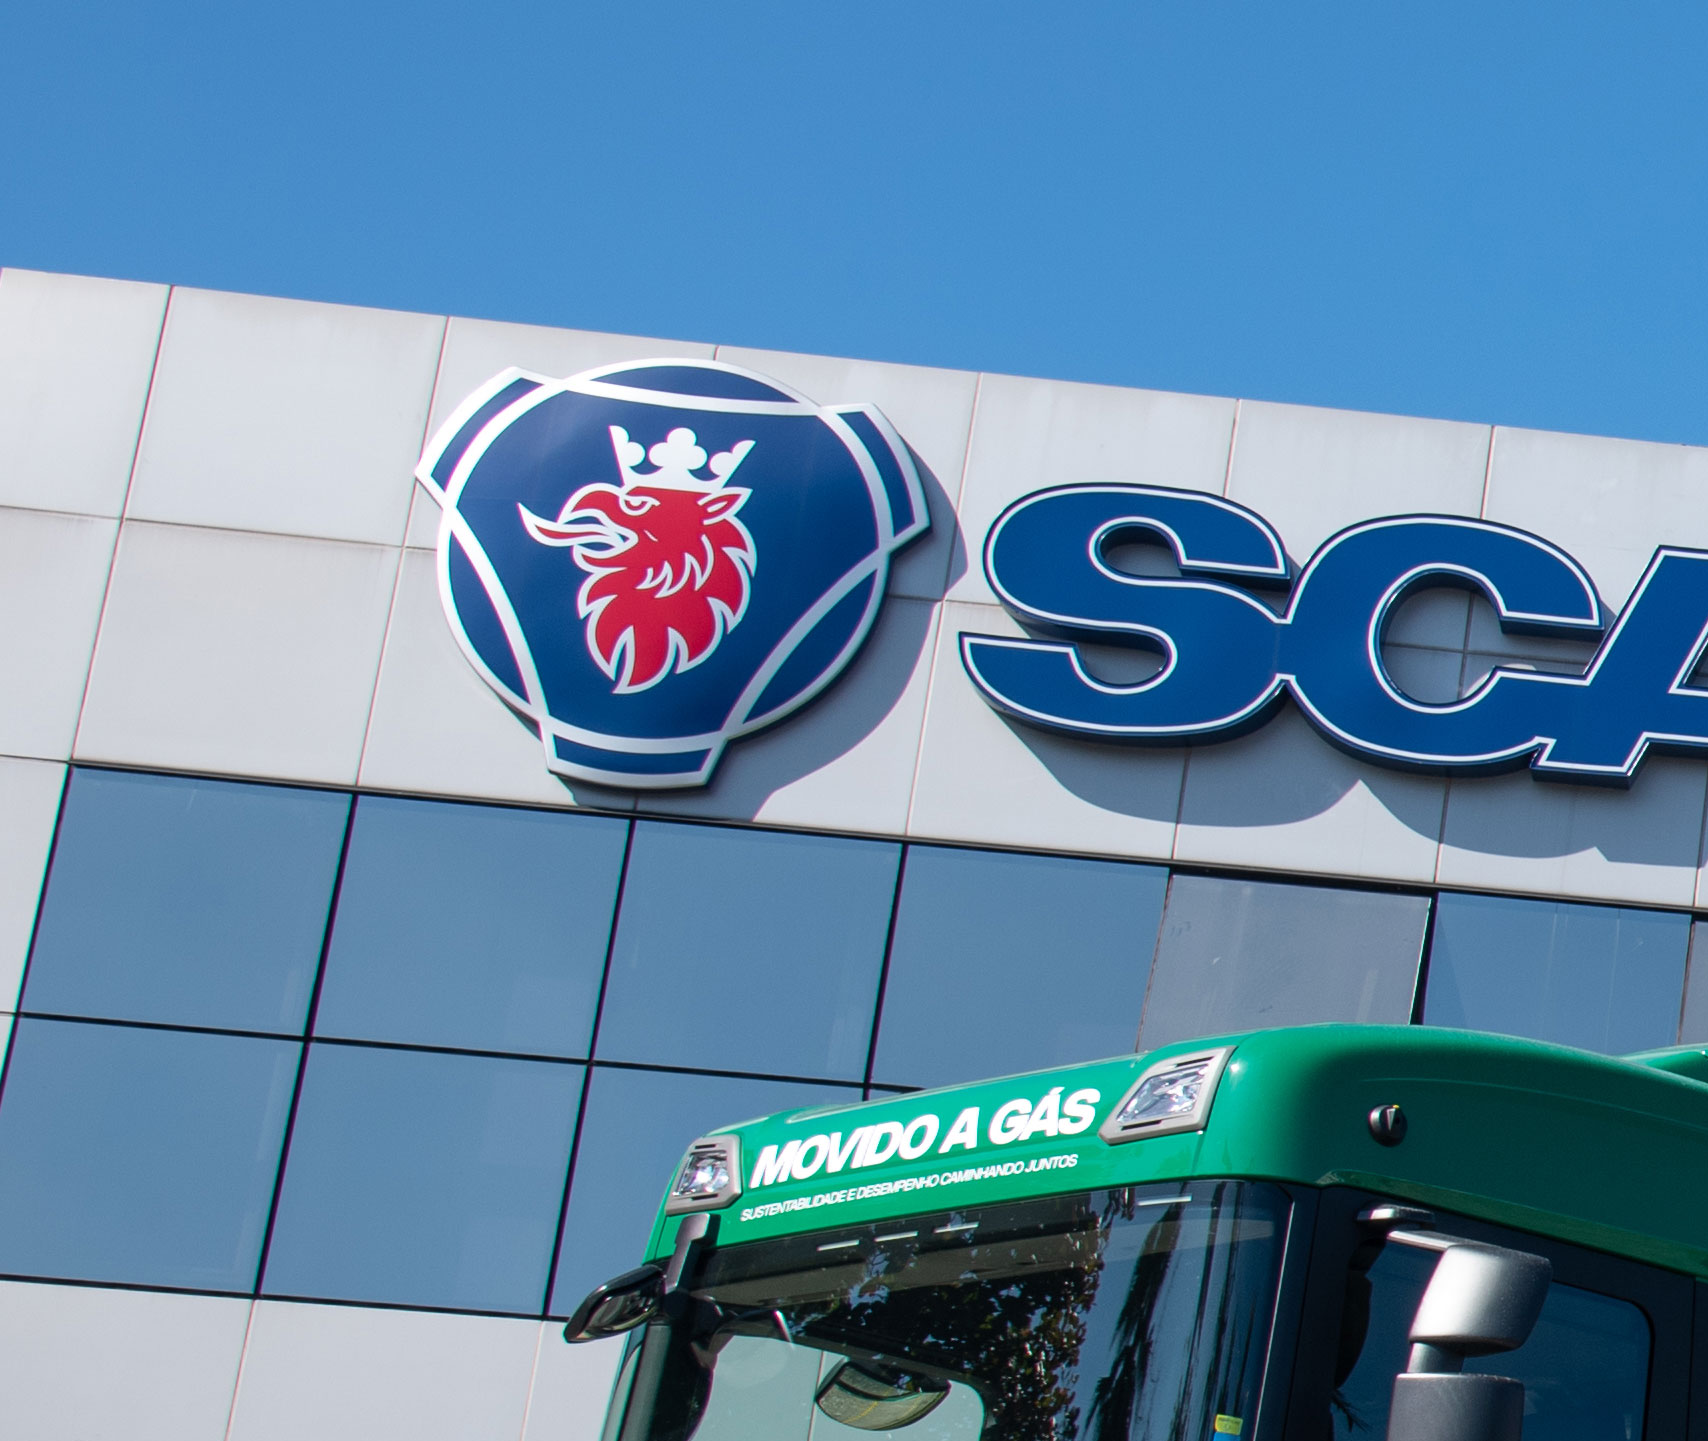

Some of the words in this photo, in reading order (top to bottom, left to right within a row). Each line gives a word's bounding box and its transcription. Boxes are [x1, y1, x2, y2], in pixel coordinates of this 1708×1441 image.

[749, 1114, 939, 1189] MOVIDO
[938, 1107, 980, 1154] A
[988, 1086, 1101, 1145] GÁS
[740, 1190, 848, 1222] SUSTENTABILIDADE
[847, 1188, 856, 1201] E
[855, 1174, 940, 1200] DESEMPENHO
[940, 1160, 1025, 1186] CAMINHANDO
[1024, 1154, 1079, 1173] JUNTOS
